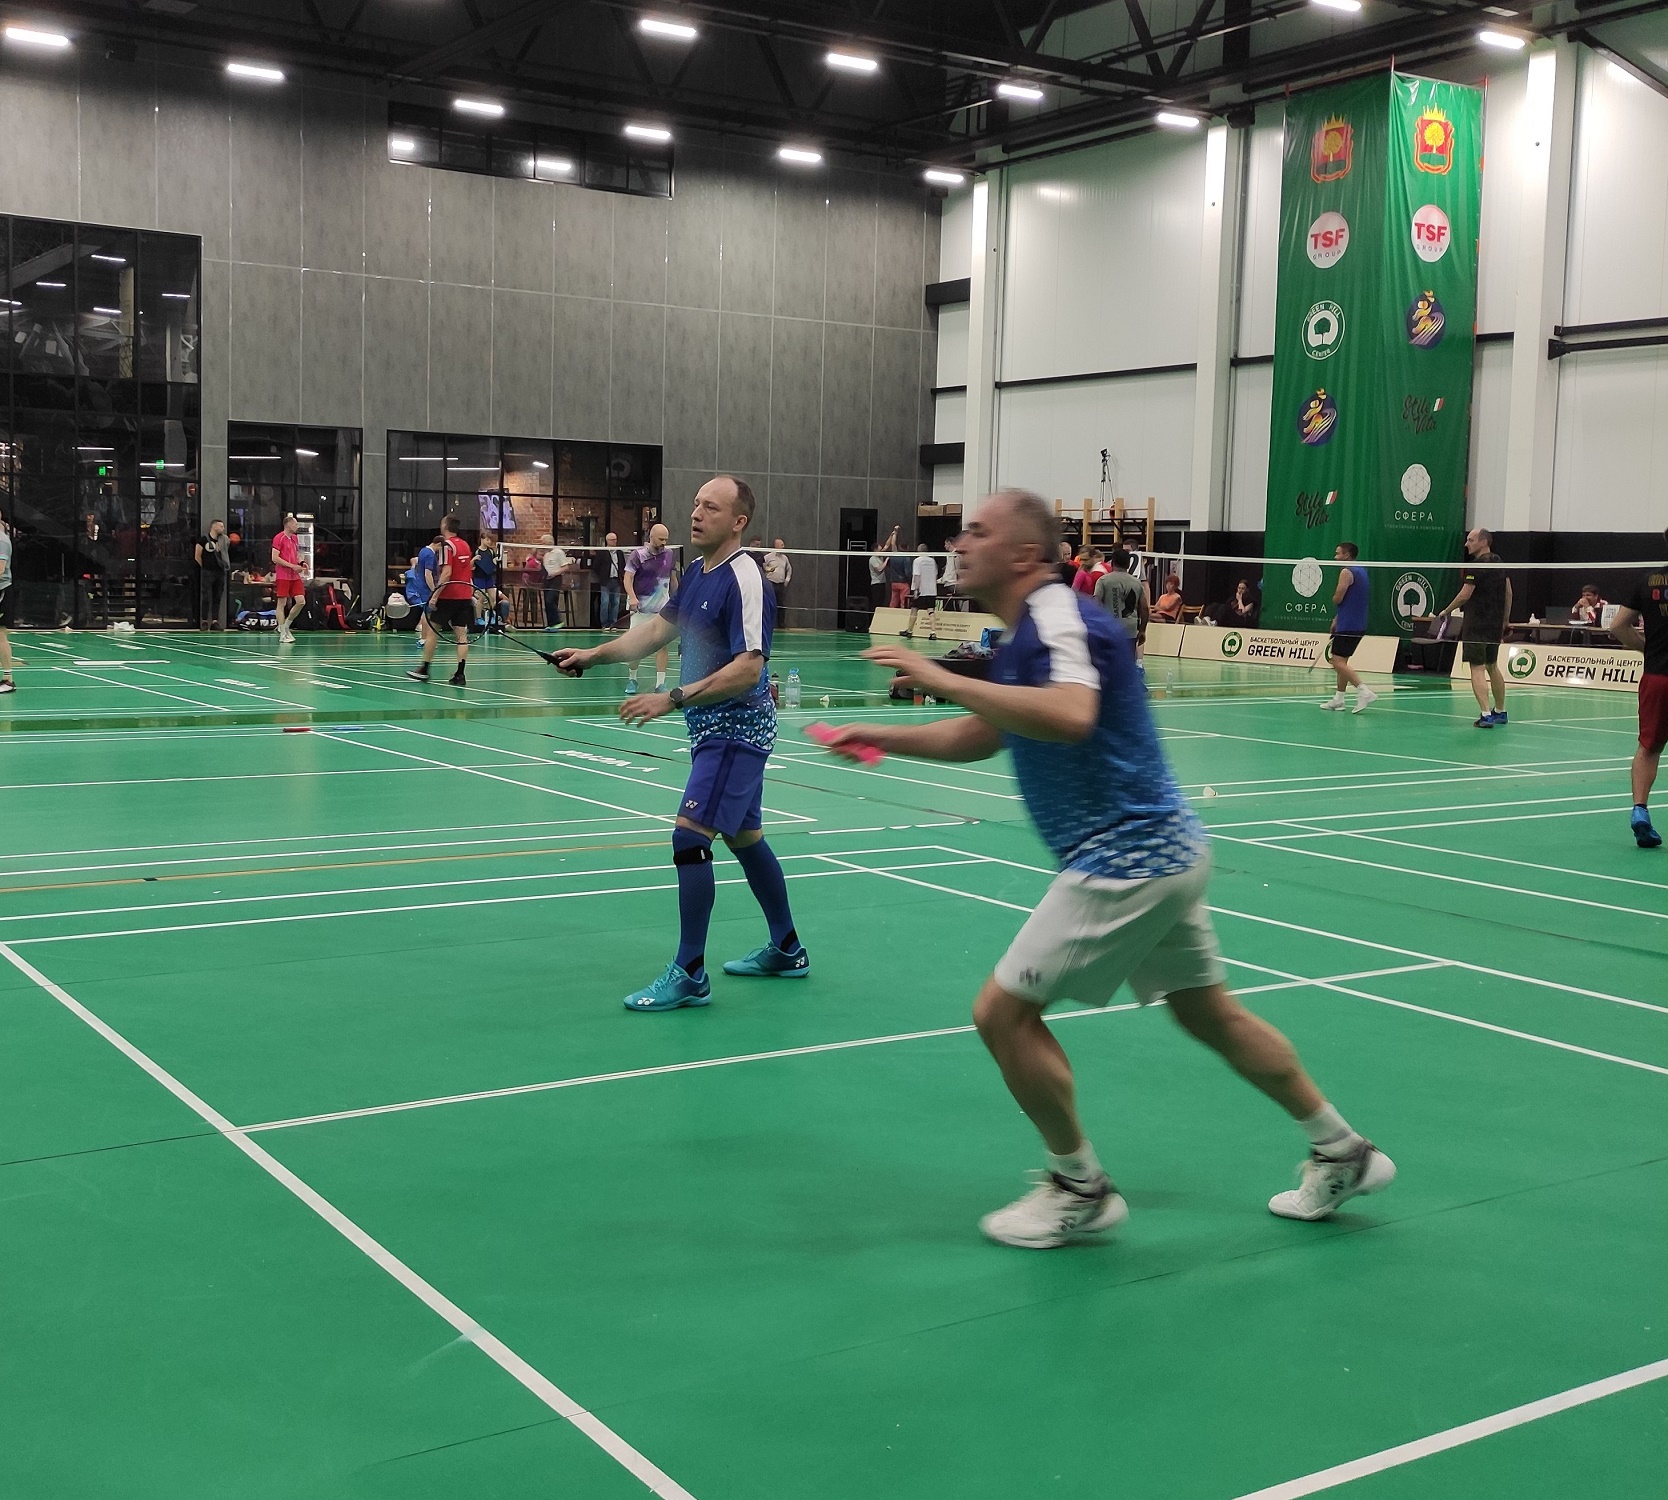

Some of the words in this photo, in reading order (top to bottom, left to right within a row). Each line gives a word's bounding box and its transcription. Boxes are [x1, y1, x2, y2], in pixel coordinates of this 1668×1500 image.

[1310, 228, 1345, 250] TSF
[1415, 222, 1447, 242] TSF
[1312, 249, 1341, 260] GROUP
[1394, 510, 1433, 522] СФЕРА
[1395, 574, 1413, 591] GREEN
[1417, 577, 1429, 591] HILL
[1285, 602, 1328, 614] СФЕРА
[1250, 636, 1299, 645] БАСКЕТБОЛЬНЫЙ
[1300, 639, 1320, 647] ЦЕНТР
[1247, 645, 1286, 659] GREEN
[1289, 647, 1316, 660] HILL
[1547, 655, 1614, 666] БАСКЕТБОЛЬНЫЙ
[1616, 660, 1643, 668] ЦЕНТР
[1544, 664, 1597, 680] GREEN
[1601, 668, 1639, 684] HILL
